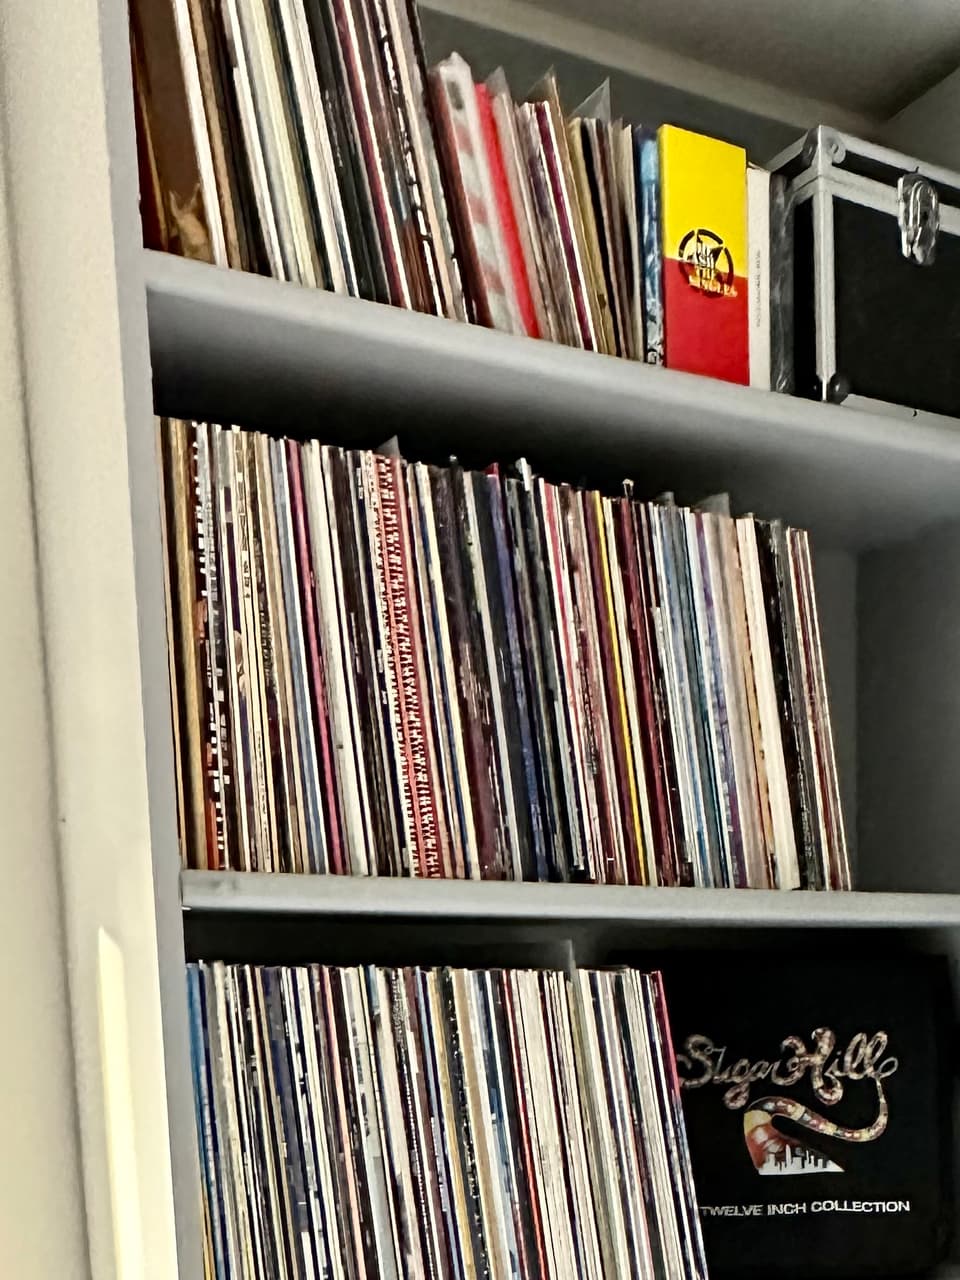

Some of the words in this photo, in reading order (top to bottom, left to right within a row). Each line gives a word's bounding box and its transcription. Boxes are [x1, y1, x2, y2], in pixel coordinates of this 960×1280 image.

[699, 1204, 764, 1217] TWELVE
[767, 1202, 806, 1216] INCH
[811, 1199, 911, 1214] COLLECTION
